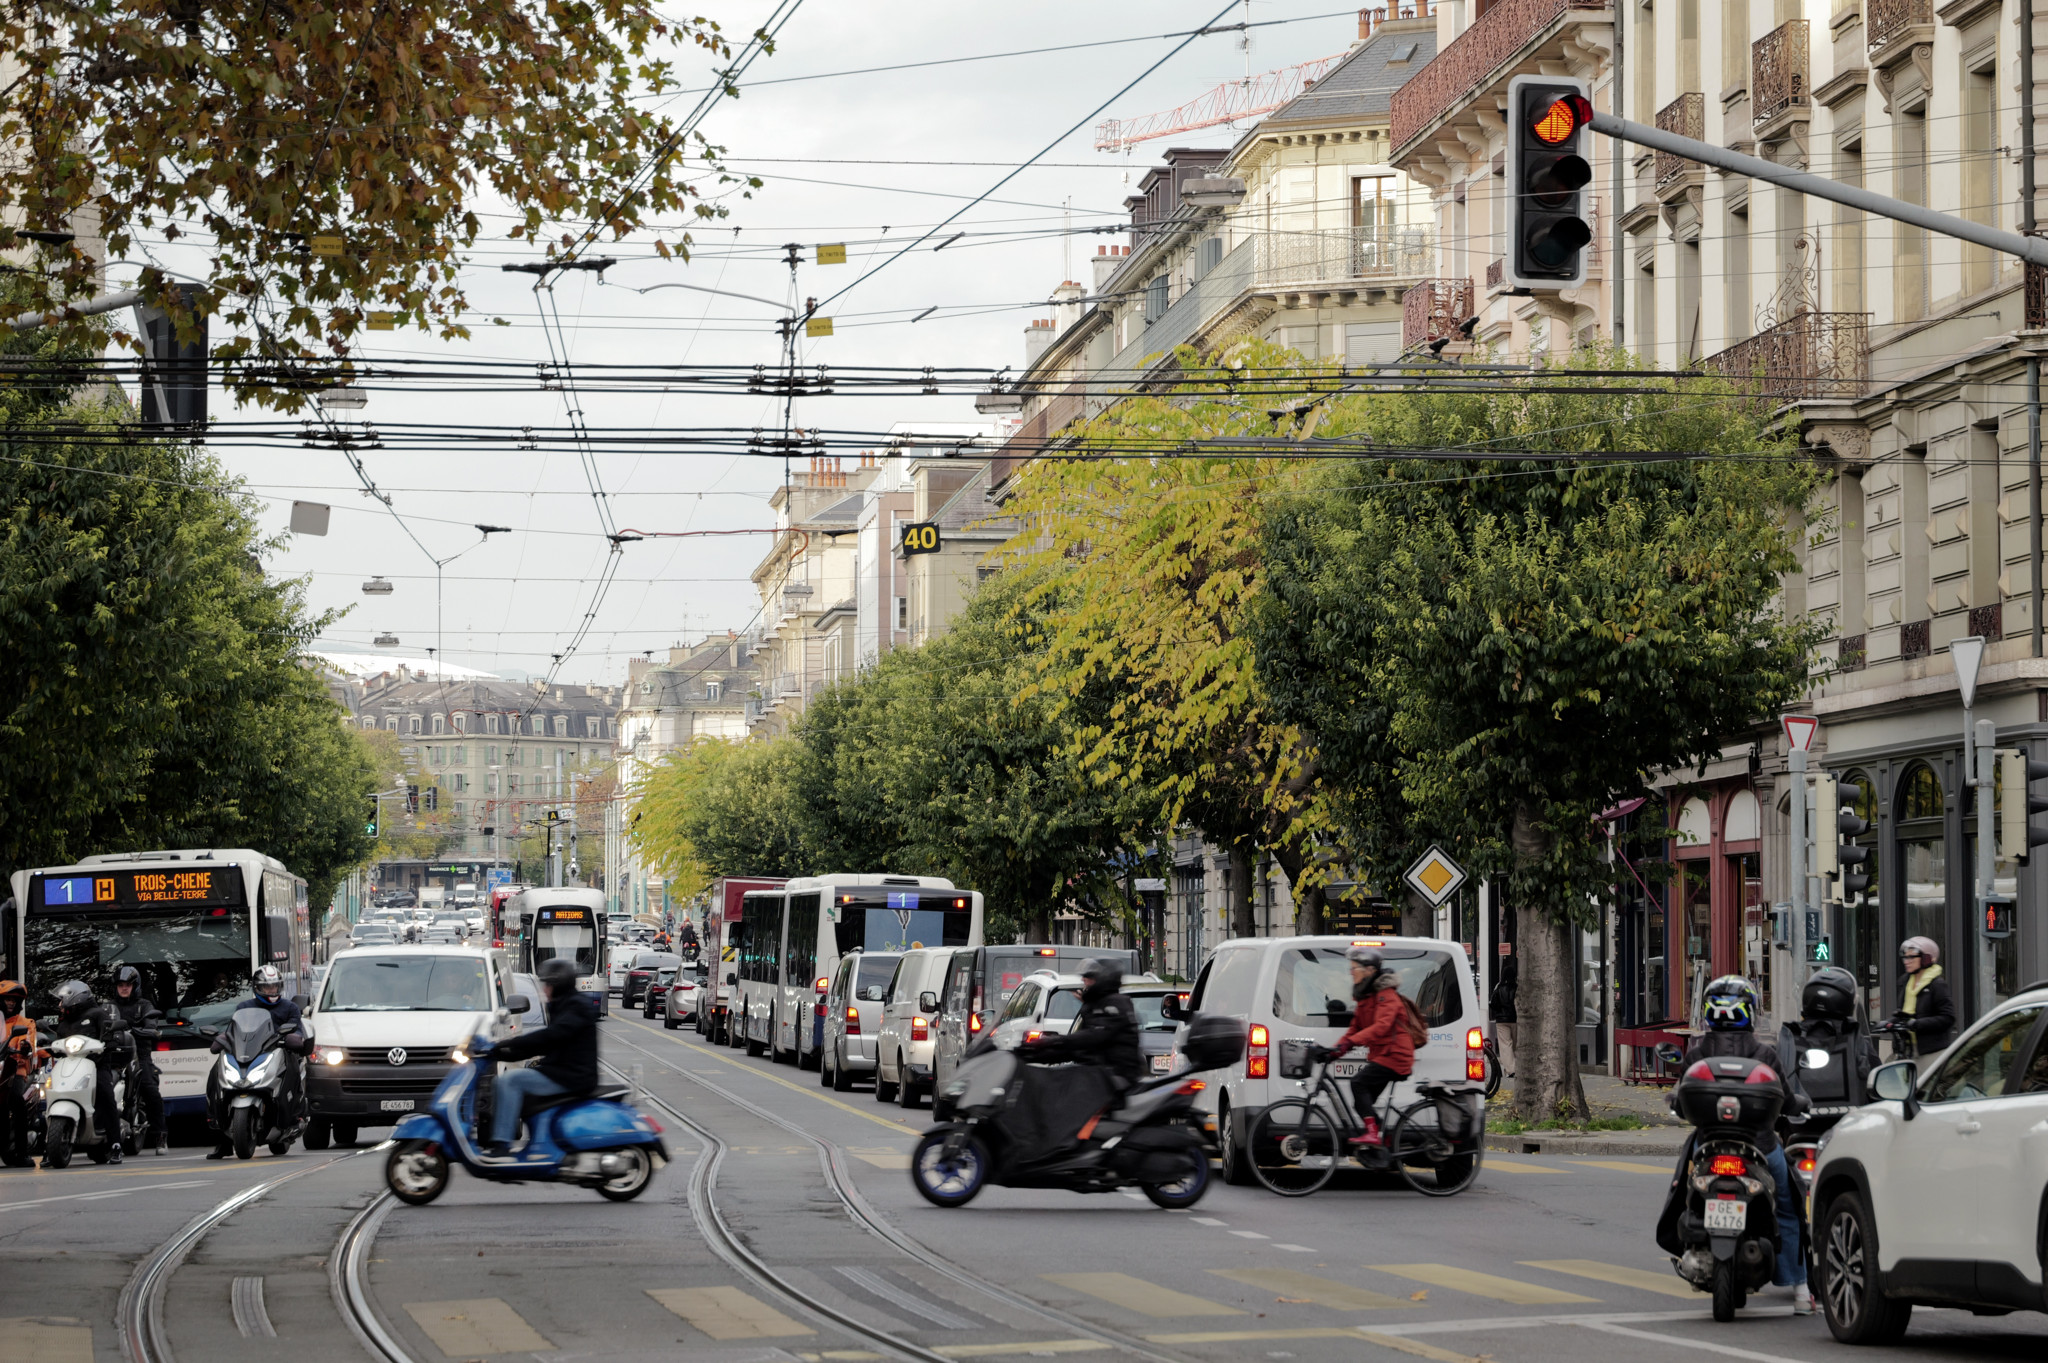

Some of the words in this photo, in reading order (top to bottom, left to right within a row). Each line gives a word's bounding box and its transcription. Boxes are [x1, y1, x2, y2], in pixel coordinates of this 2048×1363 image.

[904, 526, 937, 549] 40
[59, 880, 73, 903] 1
[133, 872, 212, 891] TROIS-CHENE
[137, 892, 152, 901] VIA
[153, 890, 208, 900] BELLE-TERRE
[897, 893, 906, 907] 1
[1427, 1033, 1454, 1041] ians
[172, 1055, 209, 1065] genevois
[1161, 1059, 1171, 1068] GE
[1718, 1202, 1734, 1214] GE
[1708, 1214, 1743, 1228] 14176
